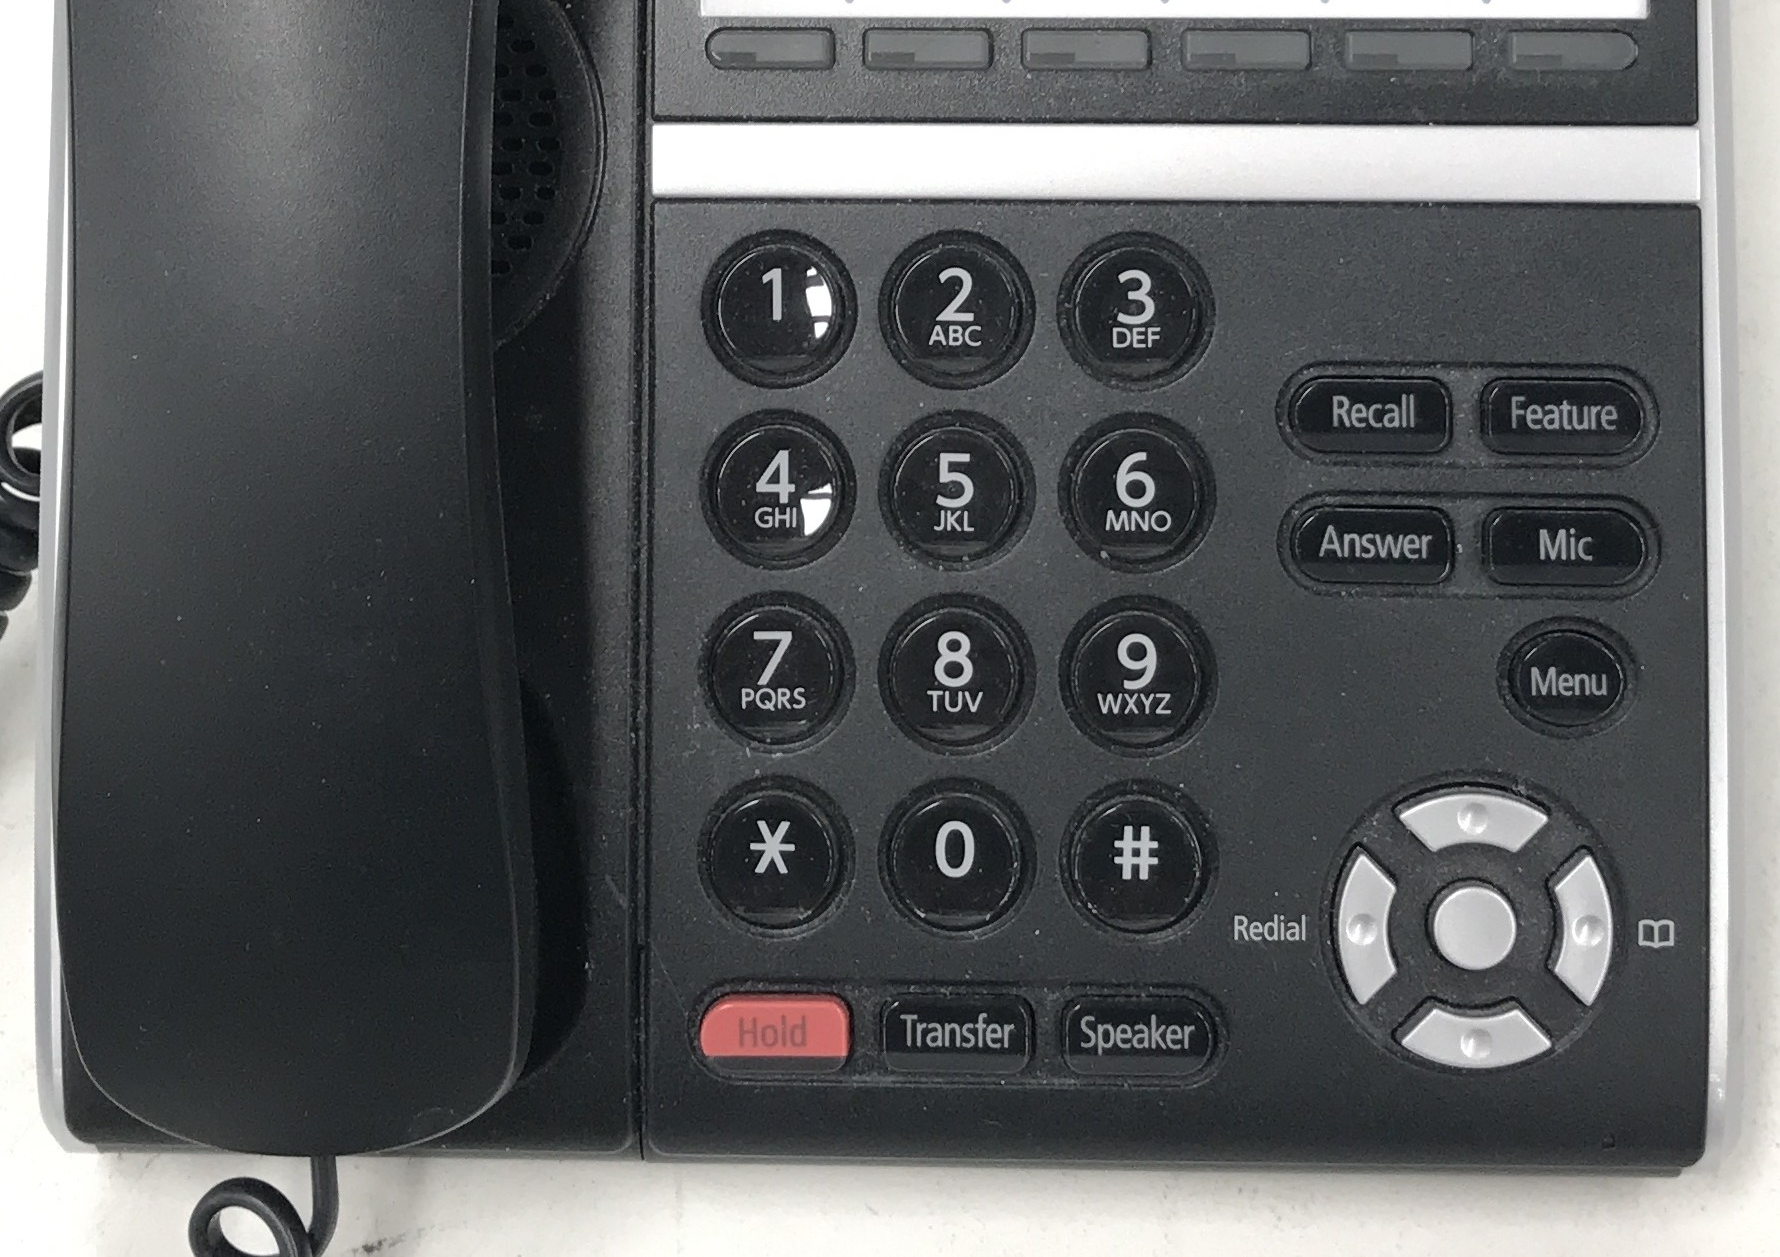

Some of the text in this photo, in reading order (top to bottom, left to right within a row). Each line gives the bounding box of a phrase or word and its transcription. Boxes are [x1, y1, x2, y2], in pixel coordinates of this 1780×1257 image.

[761, 267, 783, 323] 1
[935, 266, 976, 323] 2
[1116, 269, 1156, 323] 3
[928, 324, 982, 347] ABC
[1112, 326, 1162, 349] DEF
[1332, 393, 1415, 429] Recall
[1511, 396, 1618, 431] Feature
[754, 449, 796, 504] 4
[935, 452, 975, 506] 5
[1115, 451, 1156, 506] 6
[754, 506, 797, 529] GHI
[933, 509, 975, 532] JKL
[1105, 509, 1172, 532] MNO
[1318, 525, 1433, 560] Answer
[1539, 527, 1593, 561] Mic
[752, 629, 793, 685] 7
[933, 630, 974, 688] 8
[1116, 632, 1158, 688] 9
[1530, 666, 1608, 697] Menu
[741, 687, 807, 712] PQRS
[926, 690, 984, 713] TUV
[1097, 693, 1172, 715] WXYZ
[935, 820, 975, 878] 0
[1113, 825, 1159, 881] #
[1233, 913, 1307, 942] Redial
[738, 1015, 808, 1049] Hold
[900, 1013, 1015, 1049] Transfer
[1080, 1014, 1196, 1057] Speaker
